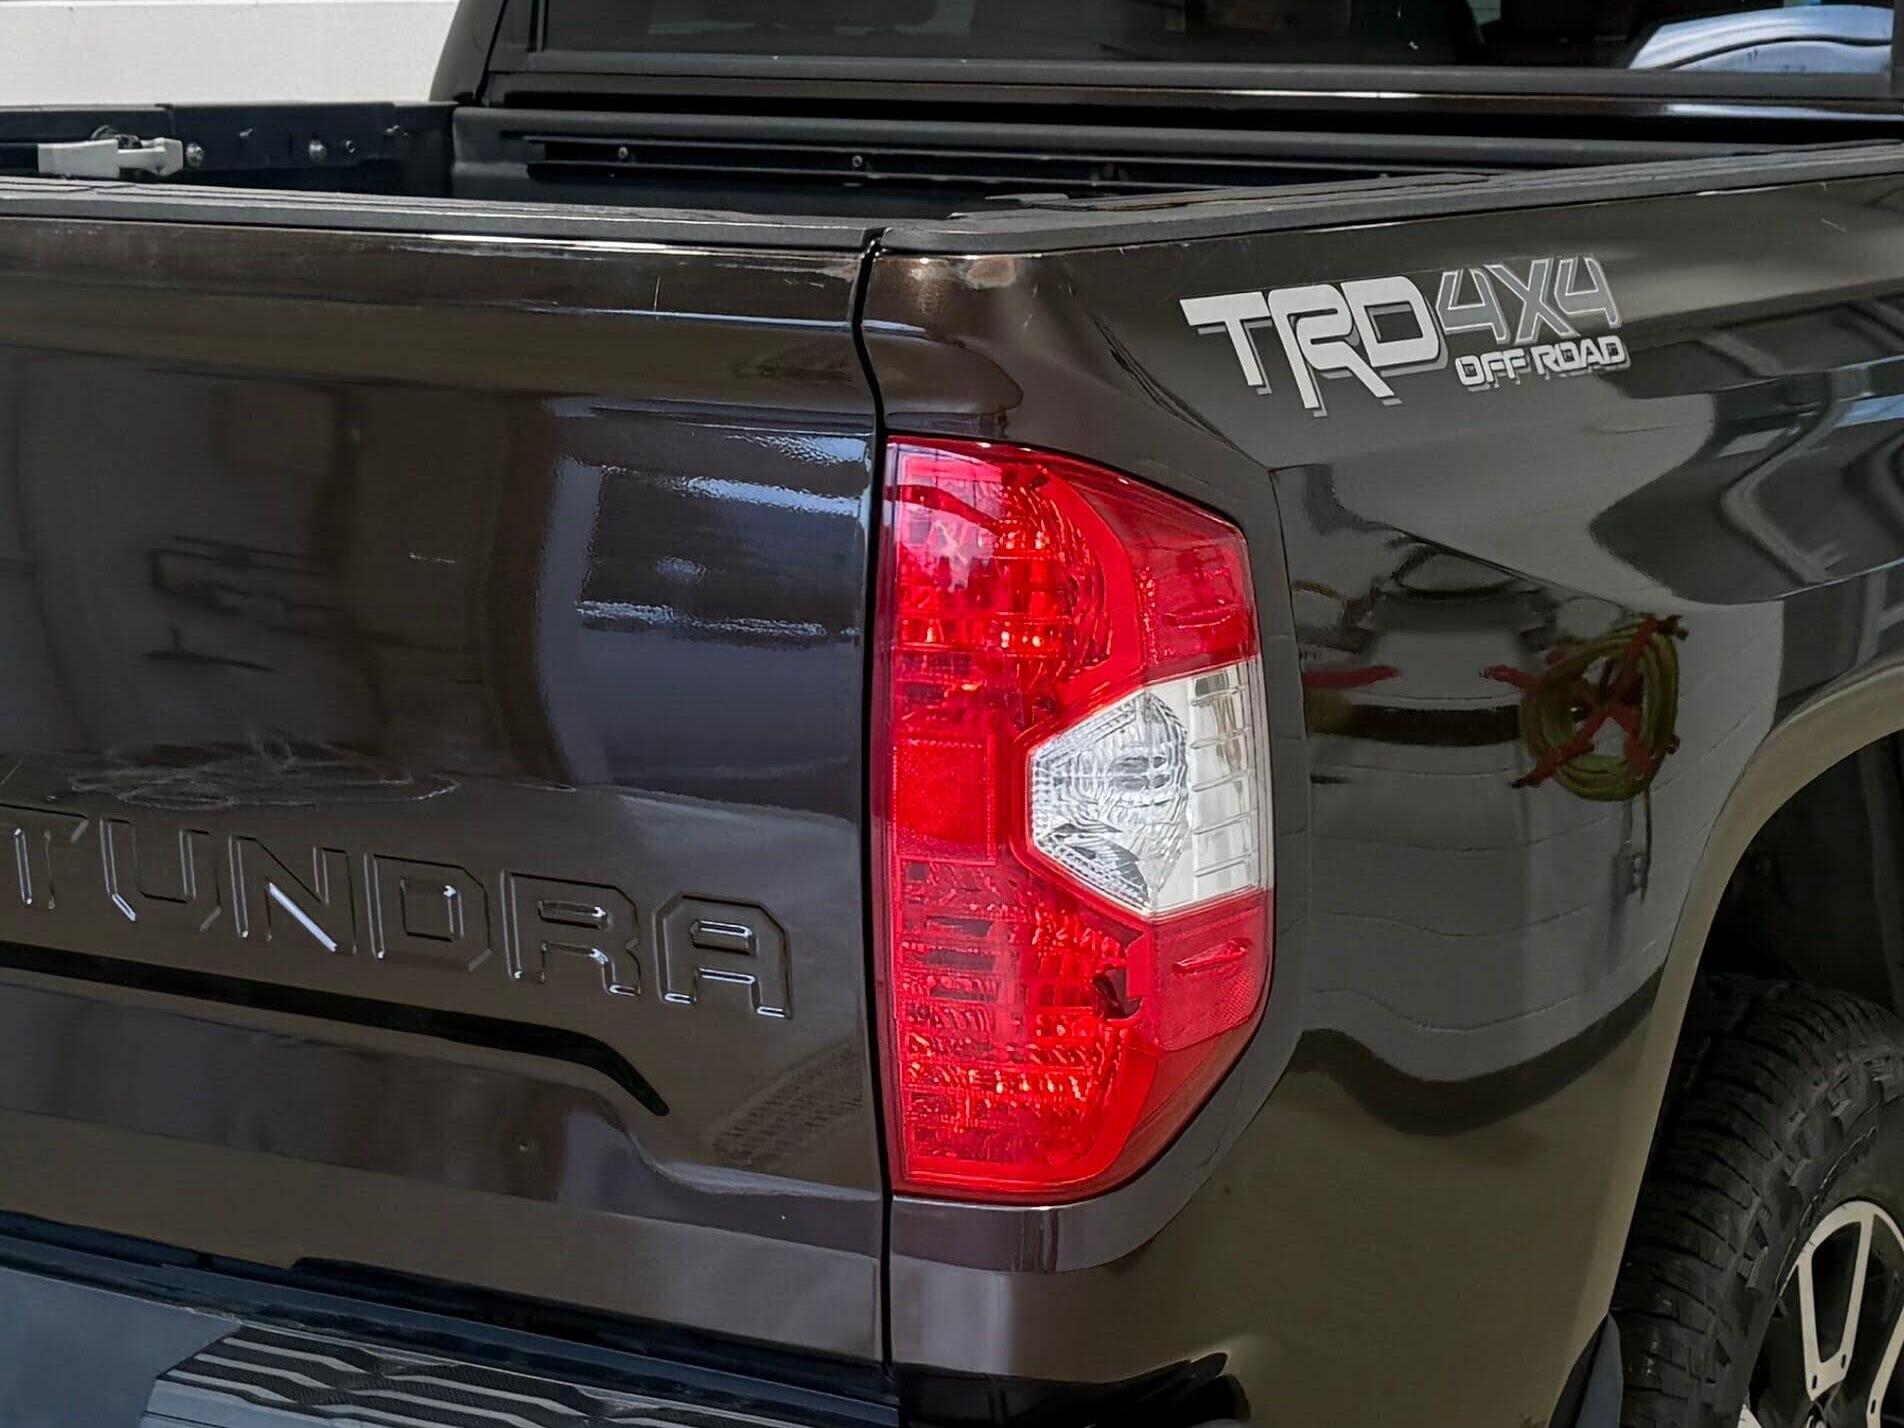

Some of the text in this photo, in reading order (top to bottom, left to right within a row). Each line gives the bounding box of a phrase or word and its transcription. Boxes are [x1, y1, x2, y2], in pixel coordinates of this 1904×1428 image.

[1179, 254, 1623, 415] TRD 4X4
[1454, 334, 1629, 388] OFF ROAD
